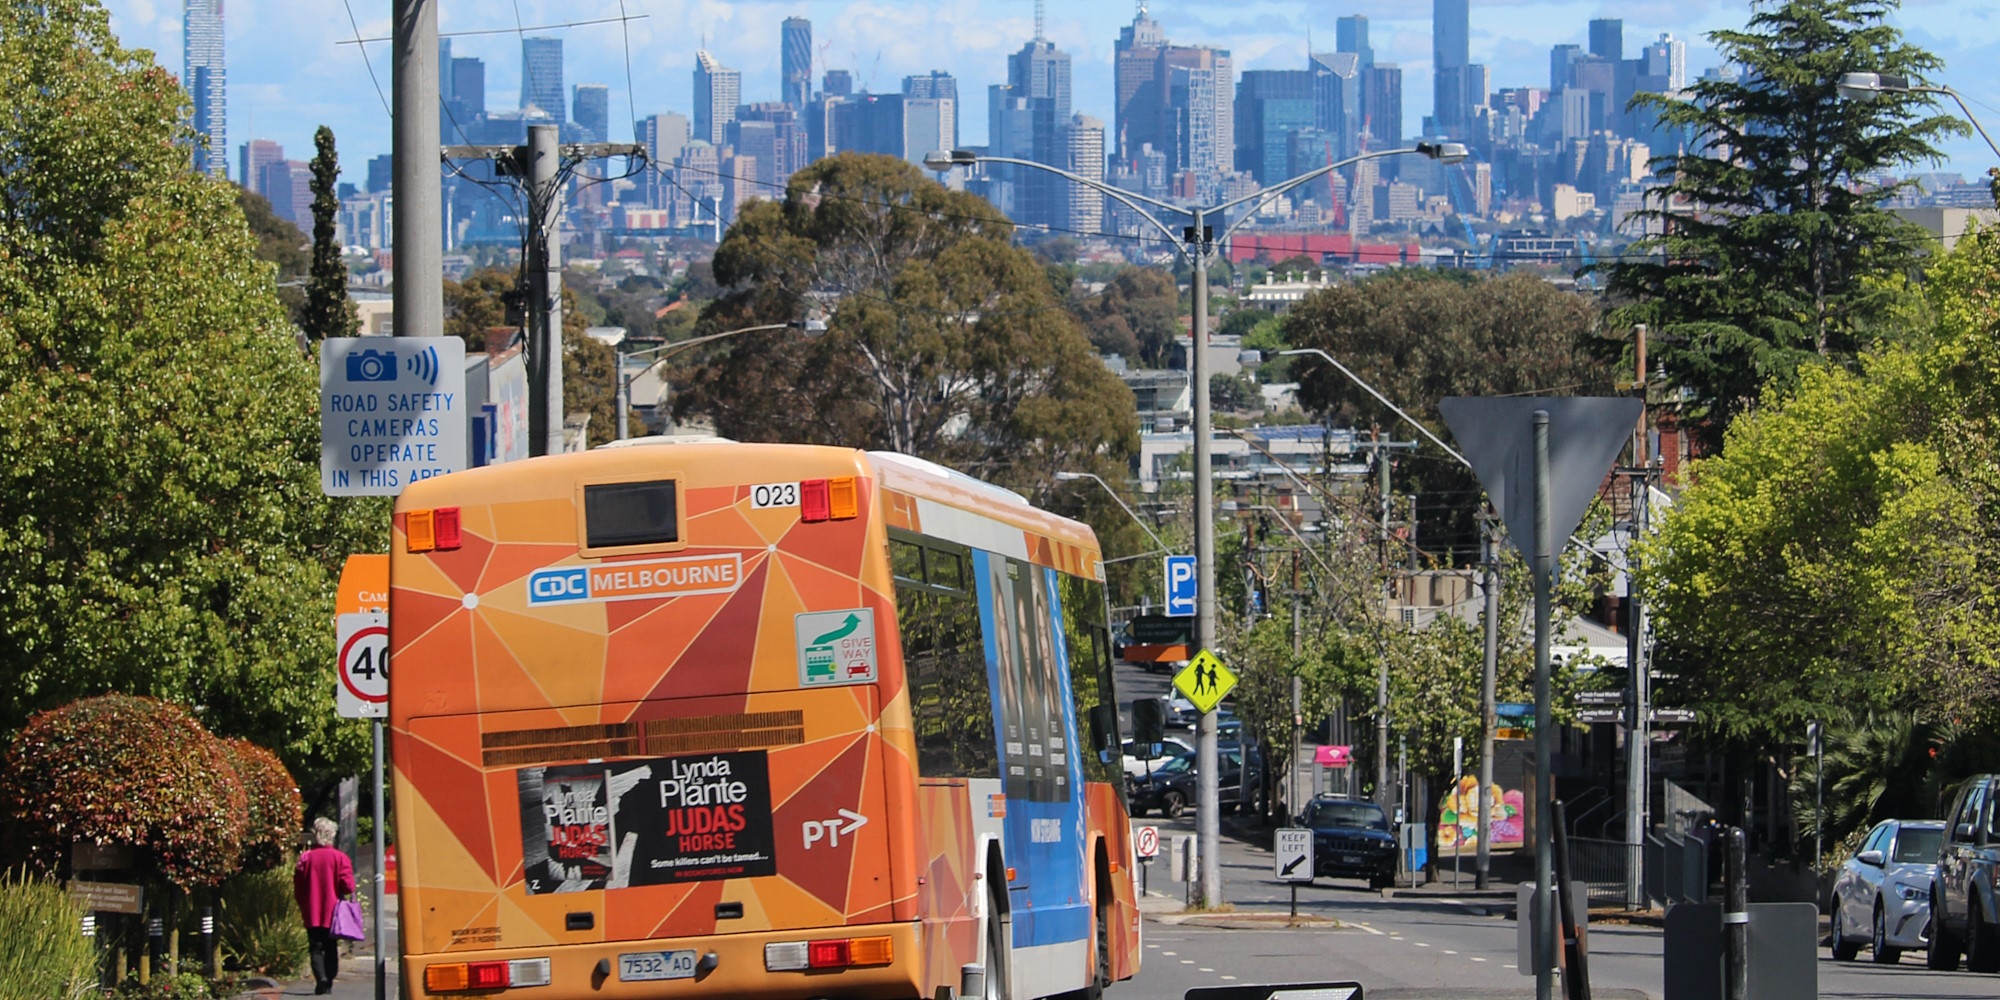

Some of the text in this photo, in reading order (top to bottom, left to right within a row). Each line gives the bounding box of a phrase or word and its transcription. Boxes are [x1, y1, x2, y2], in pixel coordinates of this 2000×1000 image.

[331, 393, 454, 412] ROAD SAFETY
[348, 419, 439, 437] CAMERAS
[351, 444, 437, 462] OPERATE
[332, 469, 452, 487] IN THIS AR
[533, 564, 734, 597] CDC MELBOURNE
[1172, 563, 1191, 592] P
[841, 637, 872, 649] GIVE
[843, 648, 872, 659] WAY
[671, 756, 732, 784] Lynda
[659, 777, 747, 808] Plante
[545, 805, 608, 825] Plante
[666, 804, 746, 837] JUDAS
[551, 824, 607, 846] JUDAS
[679, 832, 736, 853] HORSE
[1282, 833, 1306, 842] KEEP
[558, 845, 598, 859] HORSE
[1282, 844, 1305, 852] LEFT
[650, 858, 675, 868] Some
[674, 857, 699, 867] killers
[700, 855, 721, 865] can't
[721, 854, 732, 863] be
[624, 959, 663, 974] 7532
